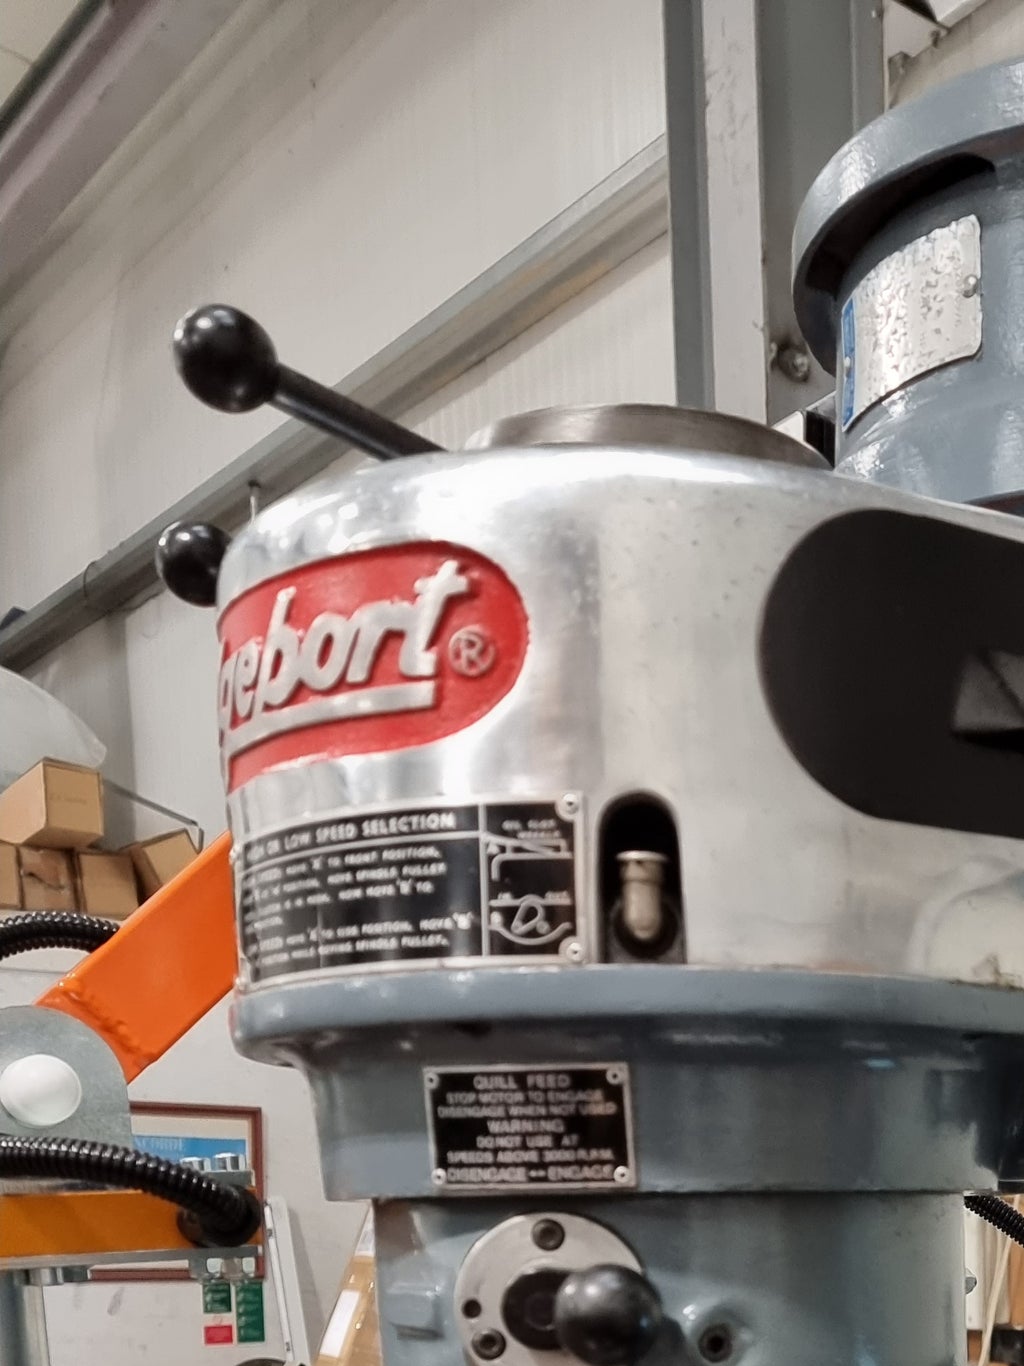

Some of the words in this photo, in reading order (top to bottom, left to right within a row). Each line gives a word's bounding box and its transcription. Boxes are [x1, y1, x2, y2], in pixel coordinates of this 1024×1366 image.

[284, 832, 311, 850] LOW
[315, 823, 357, 843] SPEED
[361, 811, 456, 837] SELECTION
[473, 1075, 518, 1090] QUILL
[526, 1074, 571, 1088] FEED
[446, 1092, 476, 1104] STOP
[478, 1091, 525, 1103] MOTOR
[528, 1090, 546, 1102] TO
[547, 1089, 604, 1102] ENGAGE
[437, 1104, 505, 1118] DISENGAGE
[508, 1103, 547, 1116] WHEN
[550, 1102, 577, 1116] NOT
[578, 1101, 618, 1115] USED
[487, 1119, 565, 1133] WARNING
[476, 1136, 495, 1148] DO
[496, 1135, 522, 1148] NOT
[526, 1135, 552, 1148] USE
[561, 1134, 580, 1147] AT
[447, 1151, 494, 1164] SPEEDS
[496, 1150, 539, 1163] ABOVE
[447, 1167, 528, 1182] DISENGAGE
[547, 1164, 615, 1181] ENGAGE
